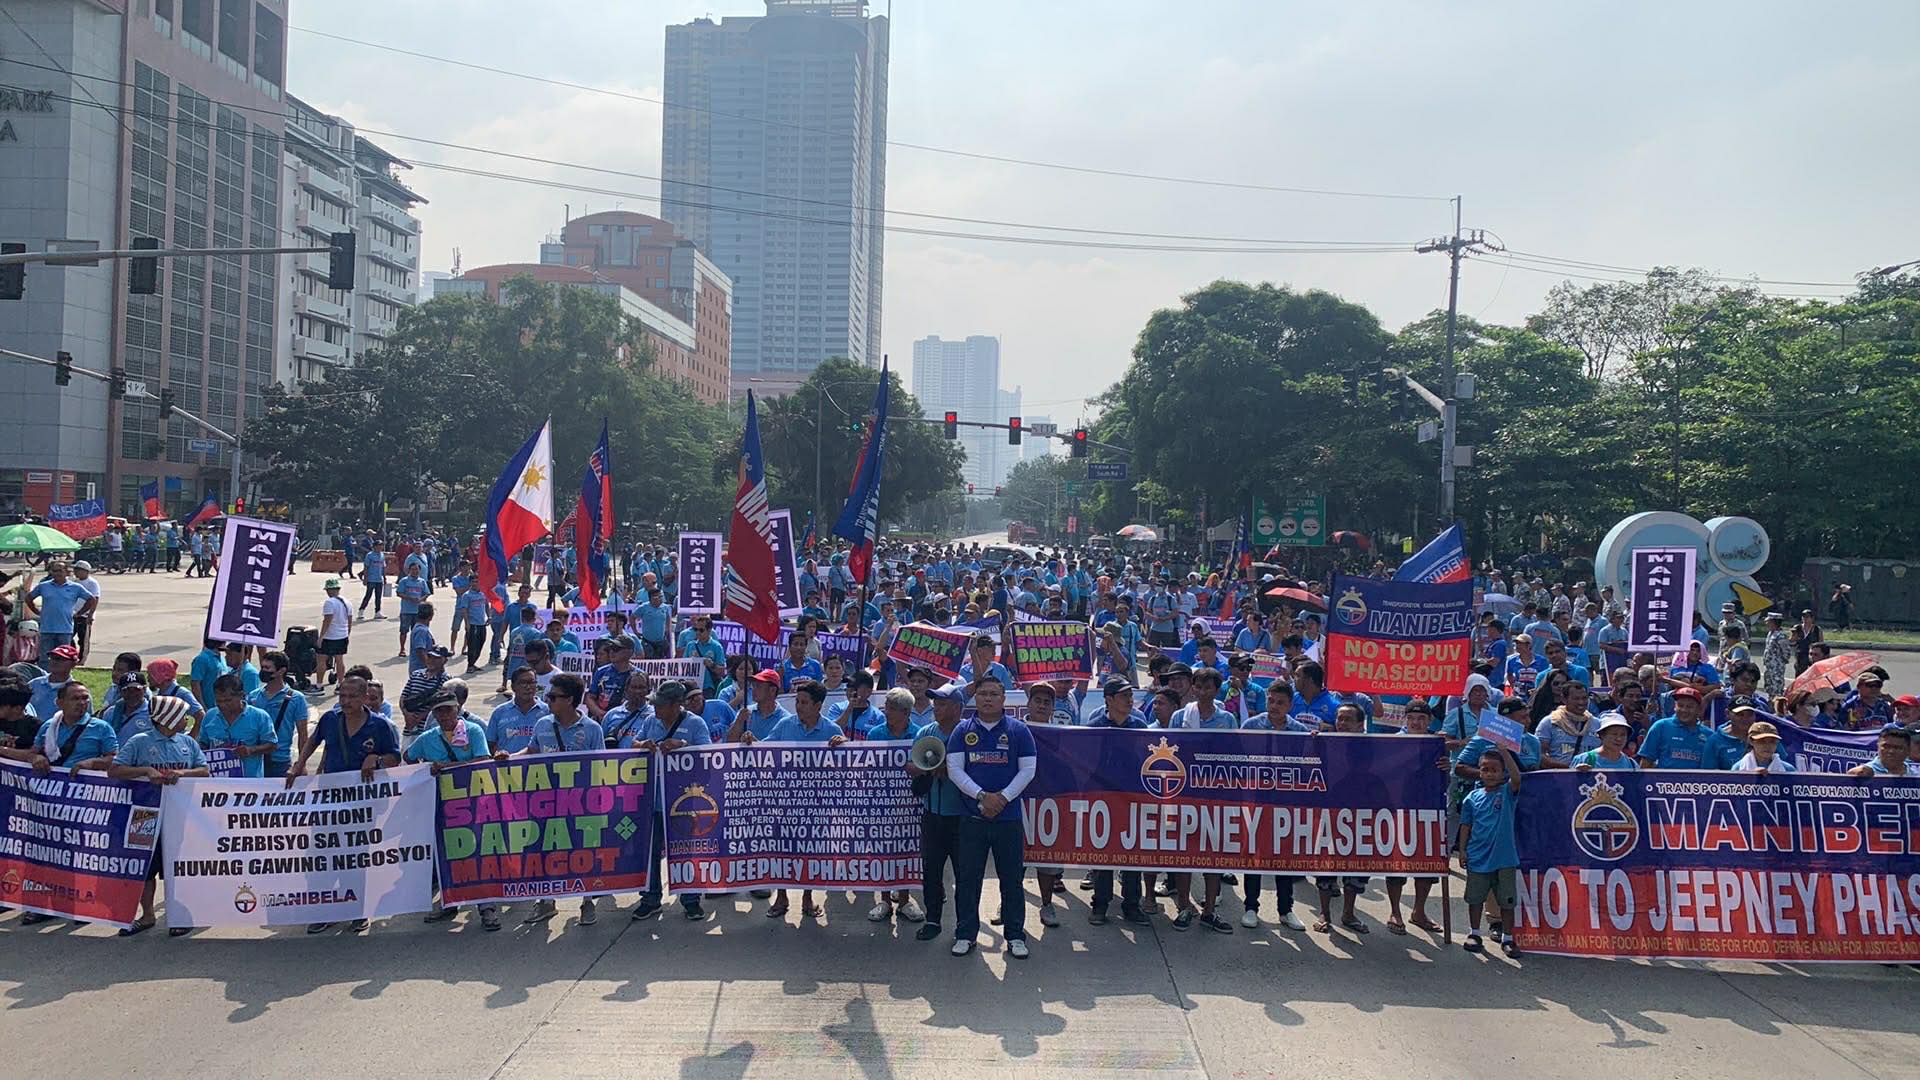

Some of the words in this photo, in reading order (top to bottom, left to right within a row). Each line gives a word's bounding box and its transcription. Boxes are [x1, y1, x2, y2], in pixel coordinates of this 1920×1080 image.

[236, 528, 277, 634] MANIBELA
[689, 539, 708, 606] MANIBELA
[1644, 554, 1674, 643] MANIBELA
[1014, 624, 1063, 636] LAHAT
[1369, 609, 1473, 636] MANIBELA
[726, 642, 742, 655] AT
[899, 629, 951, 656] DAPAT
[1344, 640, 1379, 659] NO
[1385, 643, 1416, 661] TO
[1422, 644, 1462, 661] PUV
[1016, 647, 1074, 662] DAPAT
[562, 657, 582, 672] MGA
[667, 663, 682, 677] NA
[684, 662, 700, 677] YAN!
[1343, 660, 1460, 682] PHASEOUT!
[1371, 681, 1433, 690] CALABARZON
[667, 753, 694, 772] NO
[700, 752, 725, 770] TO
[731, 750, 775, 769] NAIA
[439, 761, 581, 800] LAHAT
[590, 757, 648, 787] NG
[723, 771, 757, 780] SOBRA
[760, 771, 773, 779] NA
[776, 771, 798, 779] ANG
[800, 771, 864, 779] KORAPSYON!
[725, 780, 747, 789] ANG
[749, 780, 787, 789] LAGING
[789, 779, 842, 788] APEKTADO
[845, 779, 858, 788] SA
[860, 779, 887, 788] TAAS
[1190, 764, 1327, 792] MANIBELA
[1, 770, 14, 786] NO
[13, 775, 27, 790] TO
[28, 777, 64, 797] NAIA
[66, 782, 133, 805] TERMINAL
[201, 792, 229, 808] NO
[233, 792, 258, 807] TO
[260, 791, 306, 807] NAIA
[312, 781, 402, 805] TERMINAL
[724, 790, 790, 799] PINAGBABAYAD
[845, 789, 874, 797] DOBLE
[1656, 782, 1780, 797] TRANSPORTASYON
[1793, 785, 1870, 799] KABUHAYAN
[15, 795, 111, 826] PRIVATIZATION!
[443, 784, 644, 827] SANGKOT
[724, 798, 763, 807] AIRPORT
[765, 798, 776, 806] NA
[778, 798, 819, 806] MATAGAL
[836, 798, 869, 806] NATING
[724, 808, 760, 817] ILILIPAT
[761, 808, 784, 816] LANG
[786, 808, 805, 816] ANG
[807, 808, 867, 816] PAMAMAHALA
[870, 808, 882, 816] SA
[884, 808, 915, 816] KAMAY
[228, 807, 373, 830] PRIVATIZATION!
[751, 816, 775, 824] PERO
[777, 816, 798, 824] TAYO
[813, 816, 829, 824] RIN
[831, 816, 850, 824] ANG
[1020, 798, 1060, 847] NO
[1070, 800, 1111, 849] TO
[1120, 802, 1264, 855] JEEPNEY
[1273, 807, 1447, 857] PHASEOUT!
[8, 816, 61, 842] SERBISYO
[64, 829, 80, 845] SA
[83, 831, 110, 849] TAO
[217, 834, 309, 853] SERBISYO
[315, 832, 340, 849] SA
[344, 828, 383, 846] TAO
[443, 814, 609, 860] DAPAT
[723, 825, 773, 840] HUWAG
[780, 825, 807, 838] NYO
[811, 825, 865, 838] KAMING
[669, 839, 719, 855] MANIBELA
[728, 841, 746, 855] SA
[750, 839, 792, 853] SARILI
[797, 840, 850, 854] NAMING
[853, 839, 920, 853] MANTIKA!
[24, 842, 71, 866] GAWING
[73, 852, 145, 875] NEGOSYO!
[173, 859, 243, 877] HUWAG
[248, 856, 328, 875] GAWING
[332, 845, 432, 871] NEGOSYO!
[450, 848, 620, 884] MANAGOT
[1073, 853, 1087, 862] FOR
[1112, 854, 1127, 864] AND
[1129, 854, 1139, 864] HE
[1140, 855, 1157, 865] WILL
[1159, 855, 1174, 865] BEG
[1176, 856, 1190, 865] FOR
[1215, 857, 1246, 868] DEPRIVE
[1272, 859, 1287, 868] FOR
[1320, 860, 1335, 869] AND
[1337, 860, 1346, 869] HE
[1386, 861, 1399, 870] THE
[669, 861, 695, 884] NO
[699, 860, 722, 884] TO
[726, 858, 804, 883] JEEPNEY
[807, 858, 924, 881] PHASEOUT!!!
[260, 889, 357, 907] MANIBELA
[503, 878, 586, 898] MANIBELA
[1513, 868, 1569, 929] NO
[1579, 868, 1635, 931] TO
[1648, 869, 1819, 935] JEEPNEY
[1515, 934, 1556, 947] DEPRIVE
[1567, 935, 1588, 949] MAN
[1590, 936, 1609, 949] FOR
[1641, 937, 1660, 950] AND
[1675, 938, 1698, 951] WILL
[1700, 939, 1719, 952] BEG
[1722, 939, 1741, 953] FOR
[1774, 940, 1811, 954] DEPRIVE
[1820, 940, 1841, 954] MAN
[1844, 941, 1861, 954] FOR
[1863, 941, 1899, 955] JUSTICE
